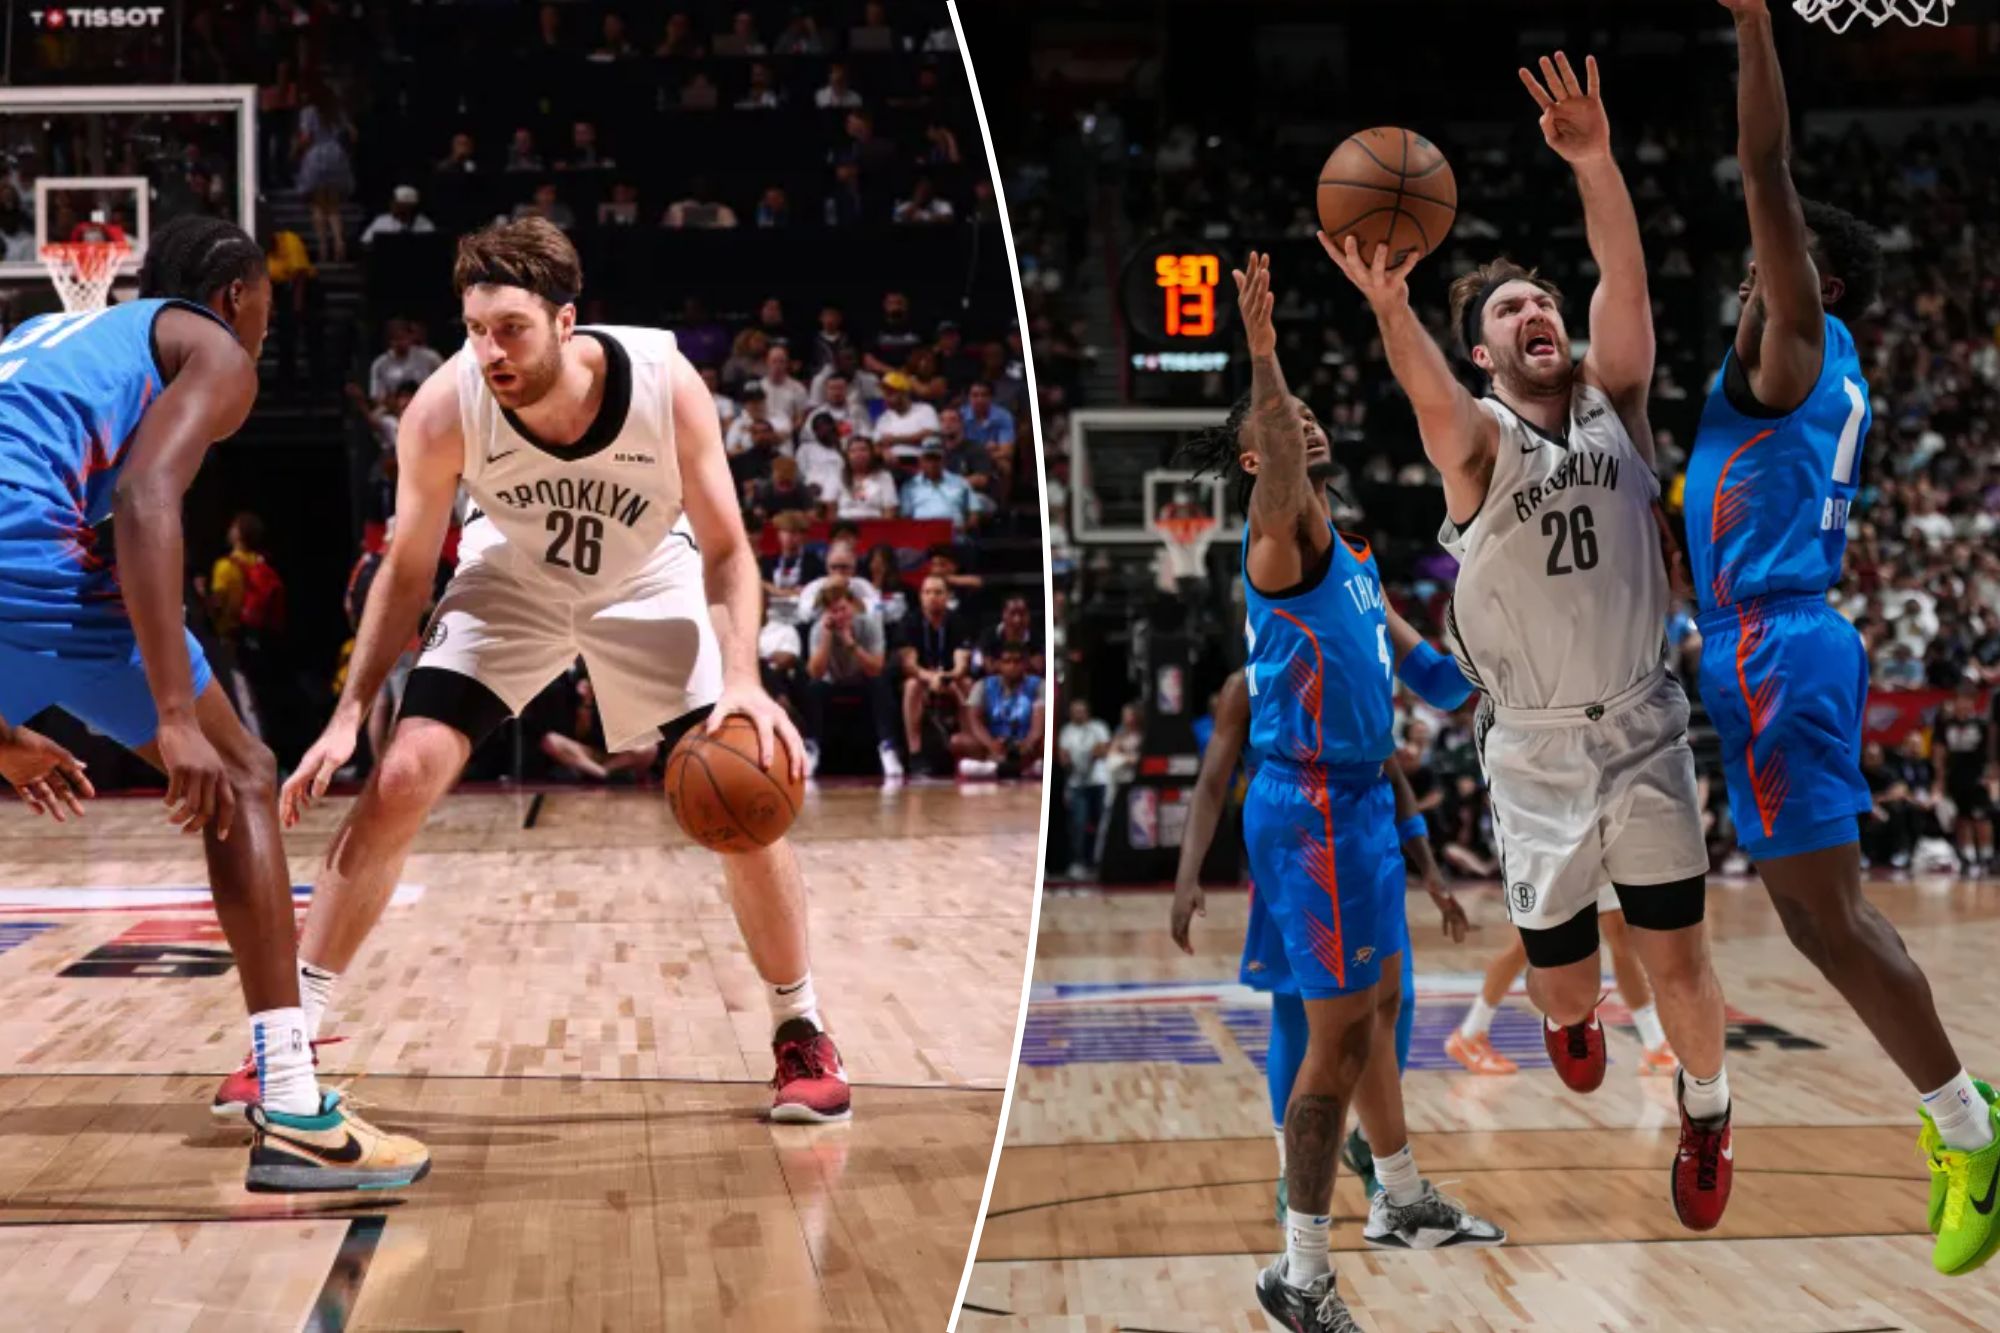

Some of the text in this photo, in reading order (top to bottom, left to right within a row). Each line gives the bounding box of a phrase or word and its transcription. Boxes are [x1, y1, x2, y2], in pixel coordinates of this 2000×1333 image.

[67, 7, 164, 27] TISSOT
[1165, 285, 1214, 336] 13
[1159, 352, 1229, 371] TISSOT
[1831, 375, 1866, 485] 1
[1512, 451, 1620, 523] BROOKLYN
[1820, 497, 1852, 531] BR
[545, 509, 604, 576] 26
[1541, 503, 1599, 577] 26
[1344, 574, 1387, 616] THU
